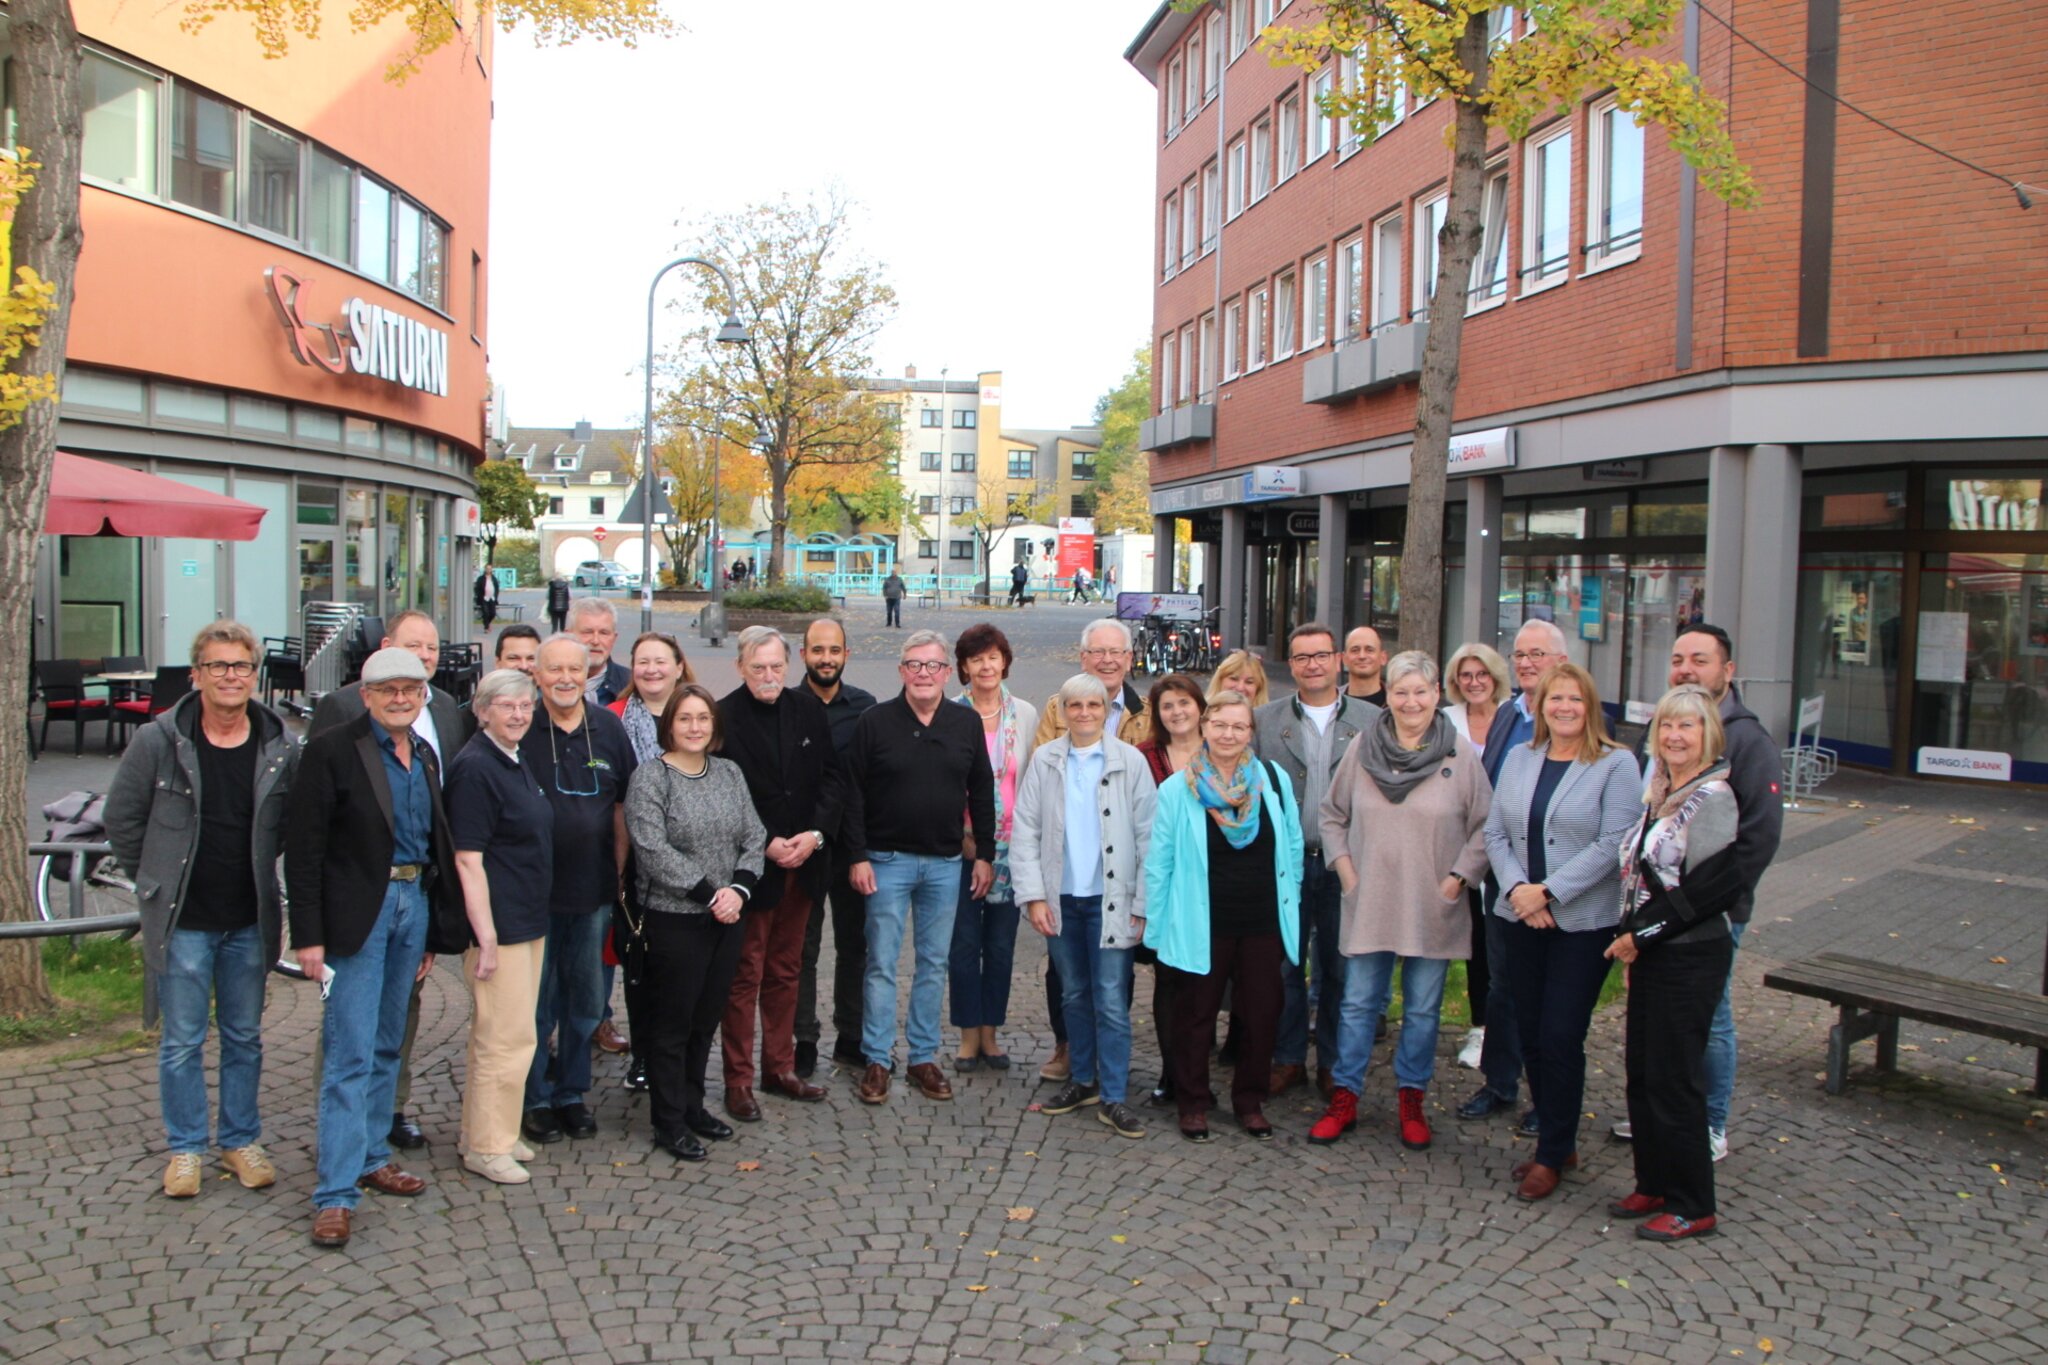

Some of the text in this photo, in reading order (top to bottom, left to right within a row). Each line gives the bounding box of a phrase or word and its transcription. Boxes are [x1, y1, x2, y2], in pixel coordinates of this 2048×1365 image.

[346, 297, 448, 397] SATURN
[1463, 443, 1487, 461] BANK
[1926, 757, 2002, 771] TARGO BANK
